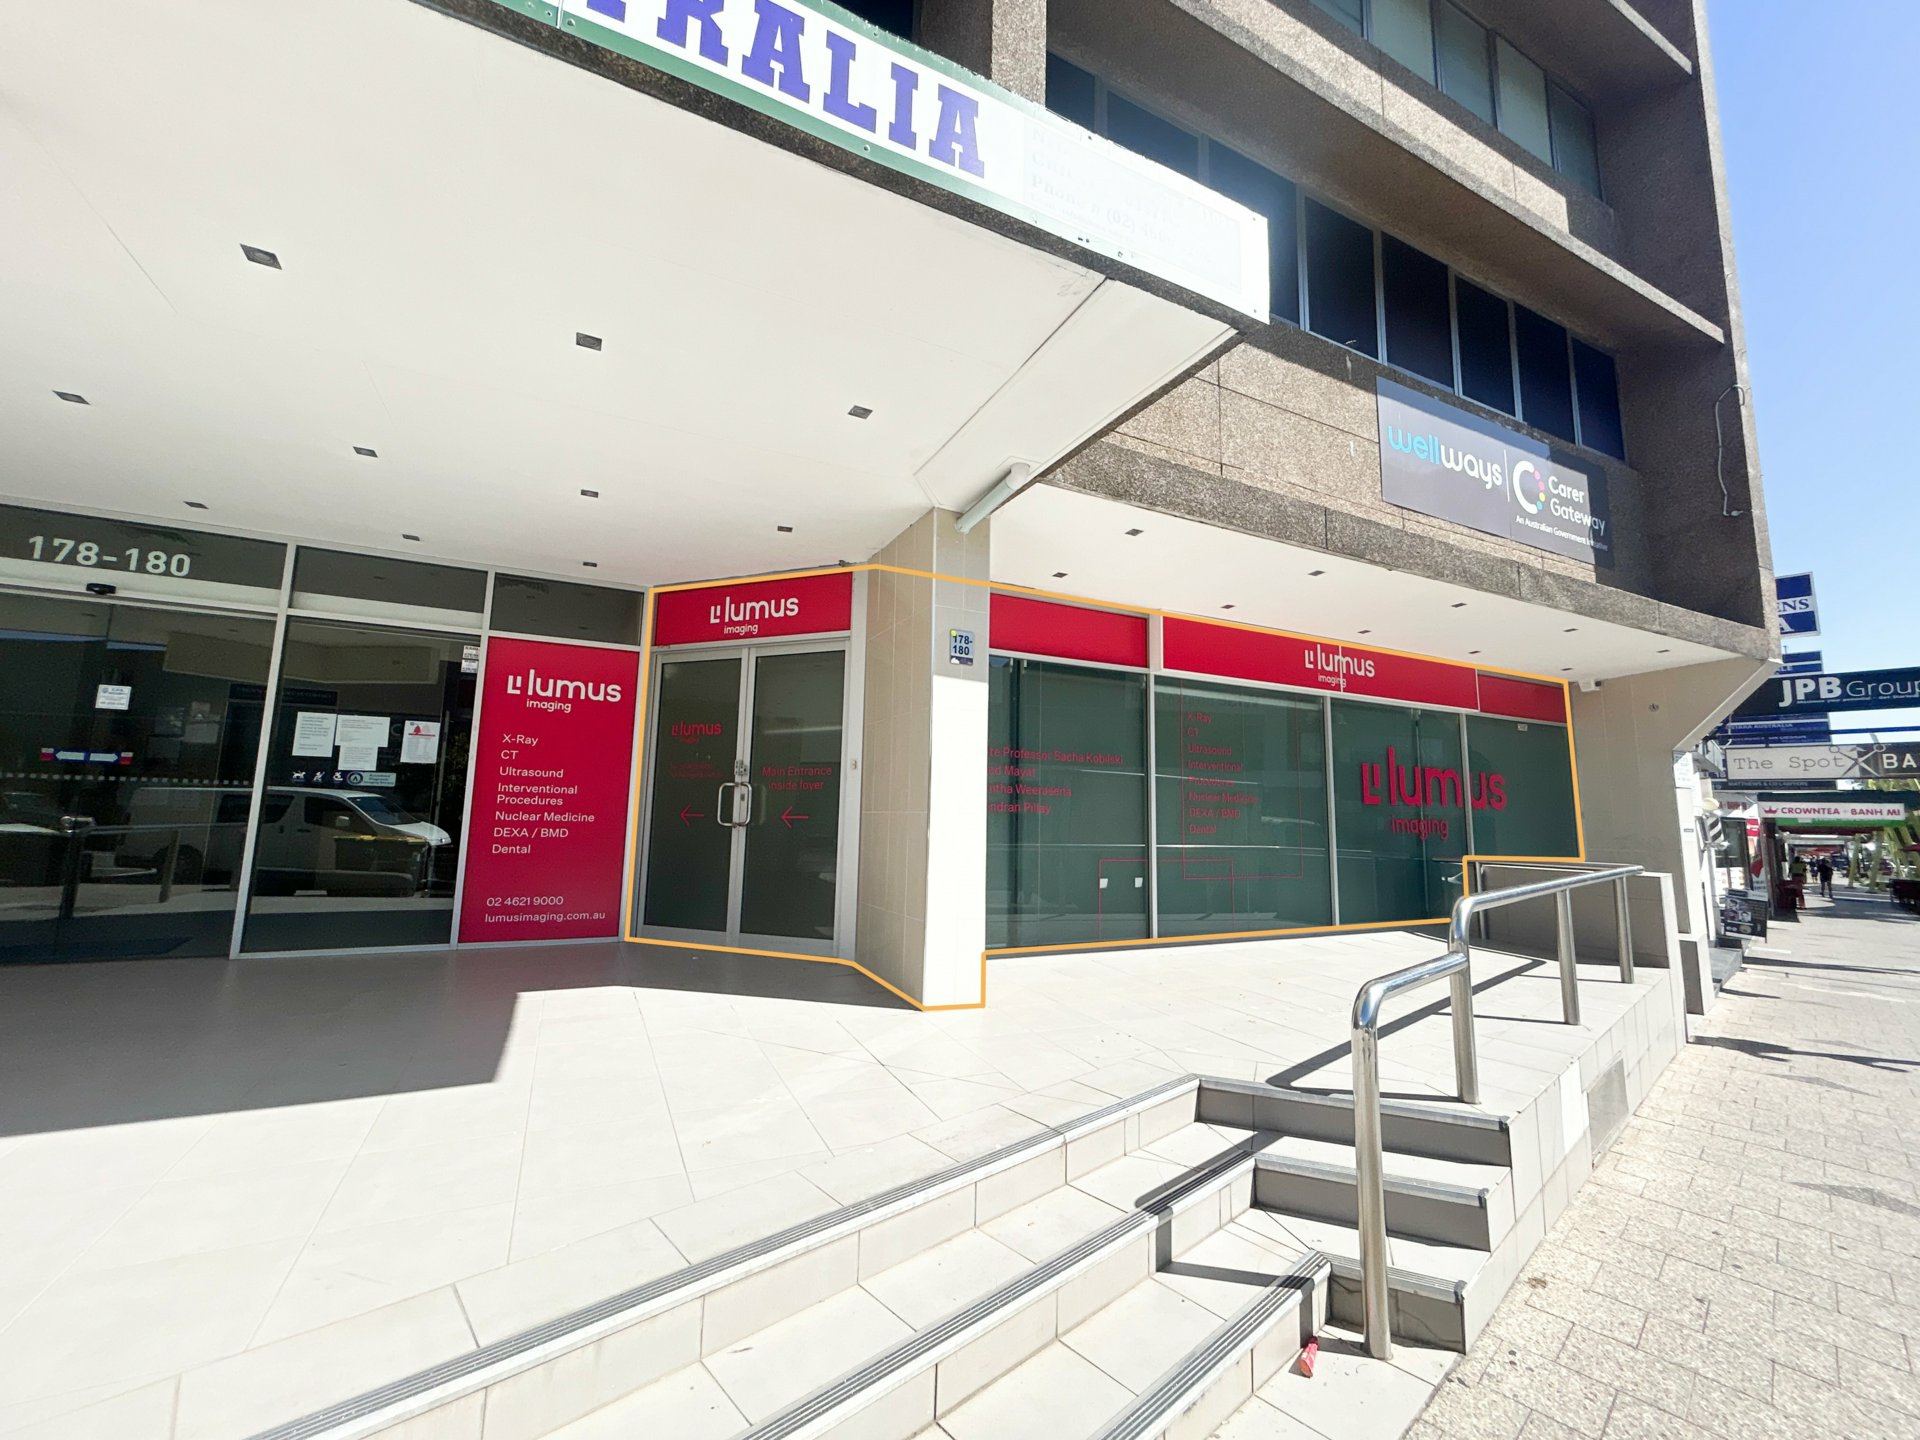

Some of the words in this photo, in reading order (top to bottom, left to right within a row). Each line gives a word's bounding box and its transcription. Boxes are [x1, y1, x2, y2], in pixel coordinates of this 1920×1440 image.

[587, 0, 985, 179] RALIA
[1388, 425, 1502, 490] wellways
[1548, 475, 1584, 503] Carer
[1550, 498, 1606, 537] Gateway
[1525, 517, 1553, 534] Australian
[1553, 527, 1587, 545] Government
[28, 535, 191, 577] 178-180
[724, 596, 799, 623] lumus
[724, 623, 759, 636] imaging
[953, 644, 970, 656] 180
[1317, 643, 1375, 678] lumus
[527, 668, 622, 702] lumus
[1318, 673, 1347, 688] imaging
[1778, 676, 1842, 707] JPB
[526, 699, 572, 713] imaging
[679, 720, 722, 736] lumus
[502, 733, 539, 747] X-Ray
[501, 749, 519, 760] CT
[1003, 747, 1050, 760] Professor
[1054, 750, 1083, 763] Sacha
[1187, 744, 1233, 756] Ultrasound
[1733, 757, 1773, 770] The
[1789, 756, 1846, 772] Spot
[1882, 753, 1917, 769] BA
[500, 766, 564, 778] Ultrasound
[762, 767, 785, 777] Main
[788, 766, 832, 776] Entrance
[1387, 744, 1508, 811] lumus
[498, 783, 578, 795] Interventional
[769, 781, 796, 790] inside
[800, 780, 825, 792] foyer
[497, 794, 564, 806] Procedures
[495, 811, 541, 822] Nuclear
[543, 812, 595, 823] Medicine
[1781, 806, 1841, 816] CROWNTEA
[1850, 808, 1883, 817] BANH
[1886, 809, 1901, 817] MI
[493, 827, 529, 838] DEXA
[531, 827, 538, 839] /
[540, 828, 569, 838] BMD
[1391, 815, 1449, 841] imaging
[492, 844, 531, 854] Dental
[486, 897, 502, 907] 02
[504, 896, 531, 907] 4621
[533, 896, 564, 906] 9000
[485, 911, 606, 923] lumusimaging.com.au
